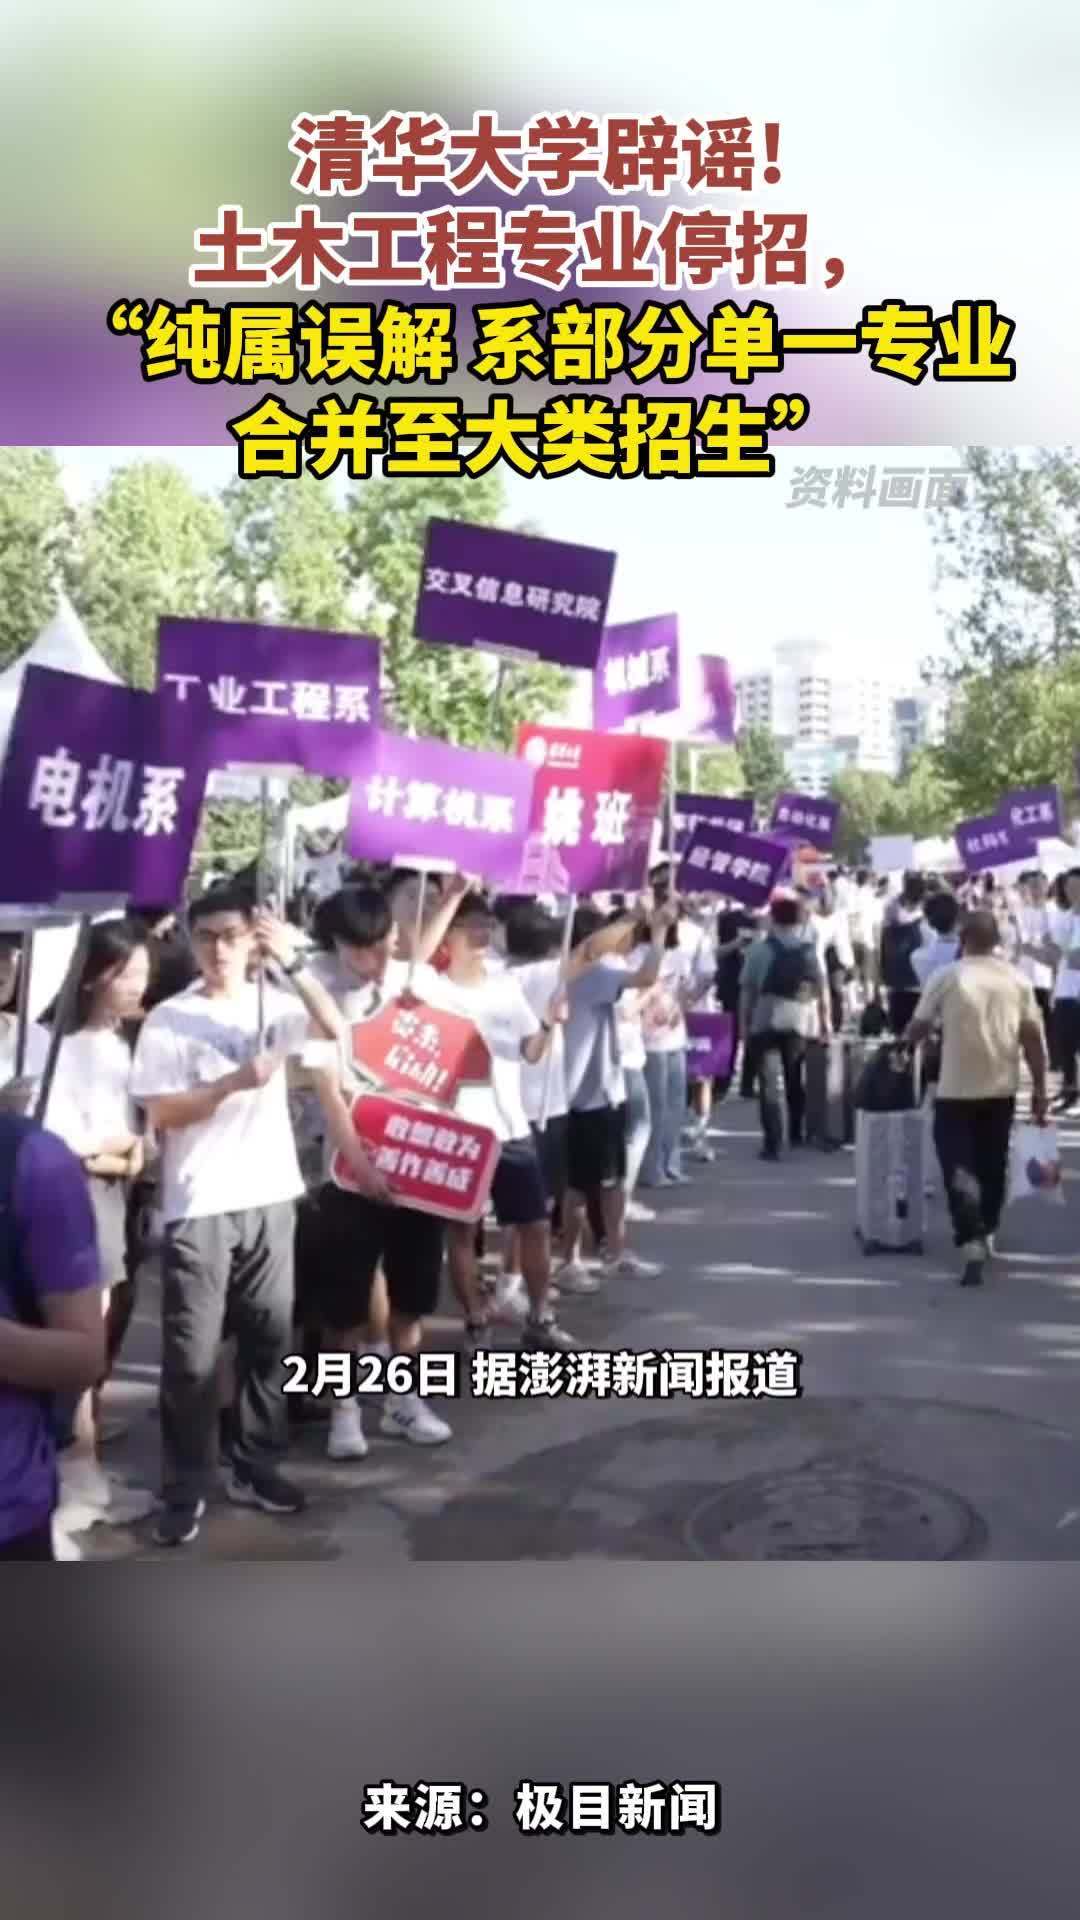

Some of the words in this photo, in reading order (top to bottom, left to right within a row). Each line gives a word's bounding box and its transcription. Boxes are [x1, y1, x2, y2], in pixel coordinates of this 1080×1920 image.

[425, 566, 603, 622] 交叉信息研究院
[28, 748, 187, 838] 电机系
[364, 775, 516, 834] 计算机系
